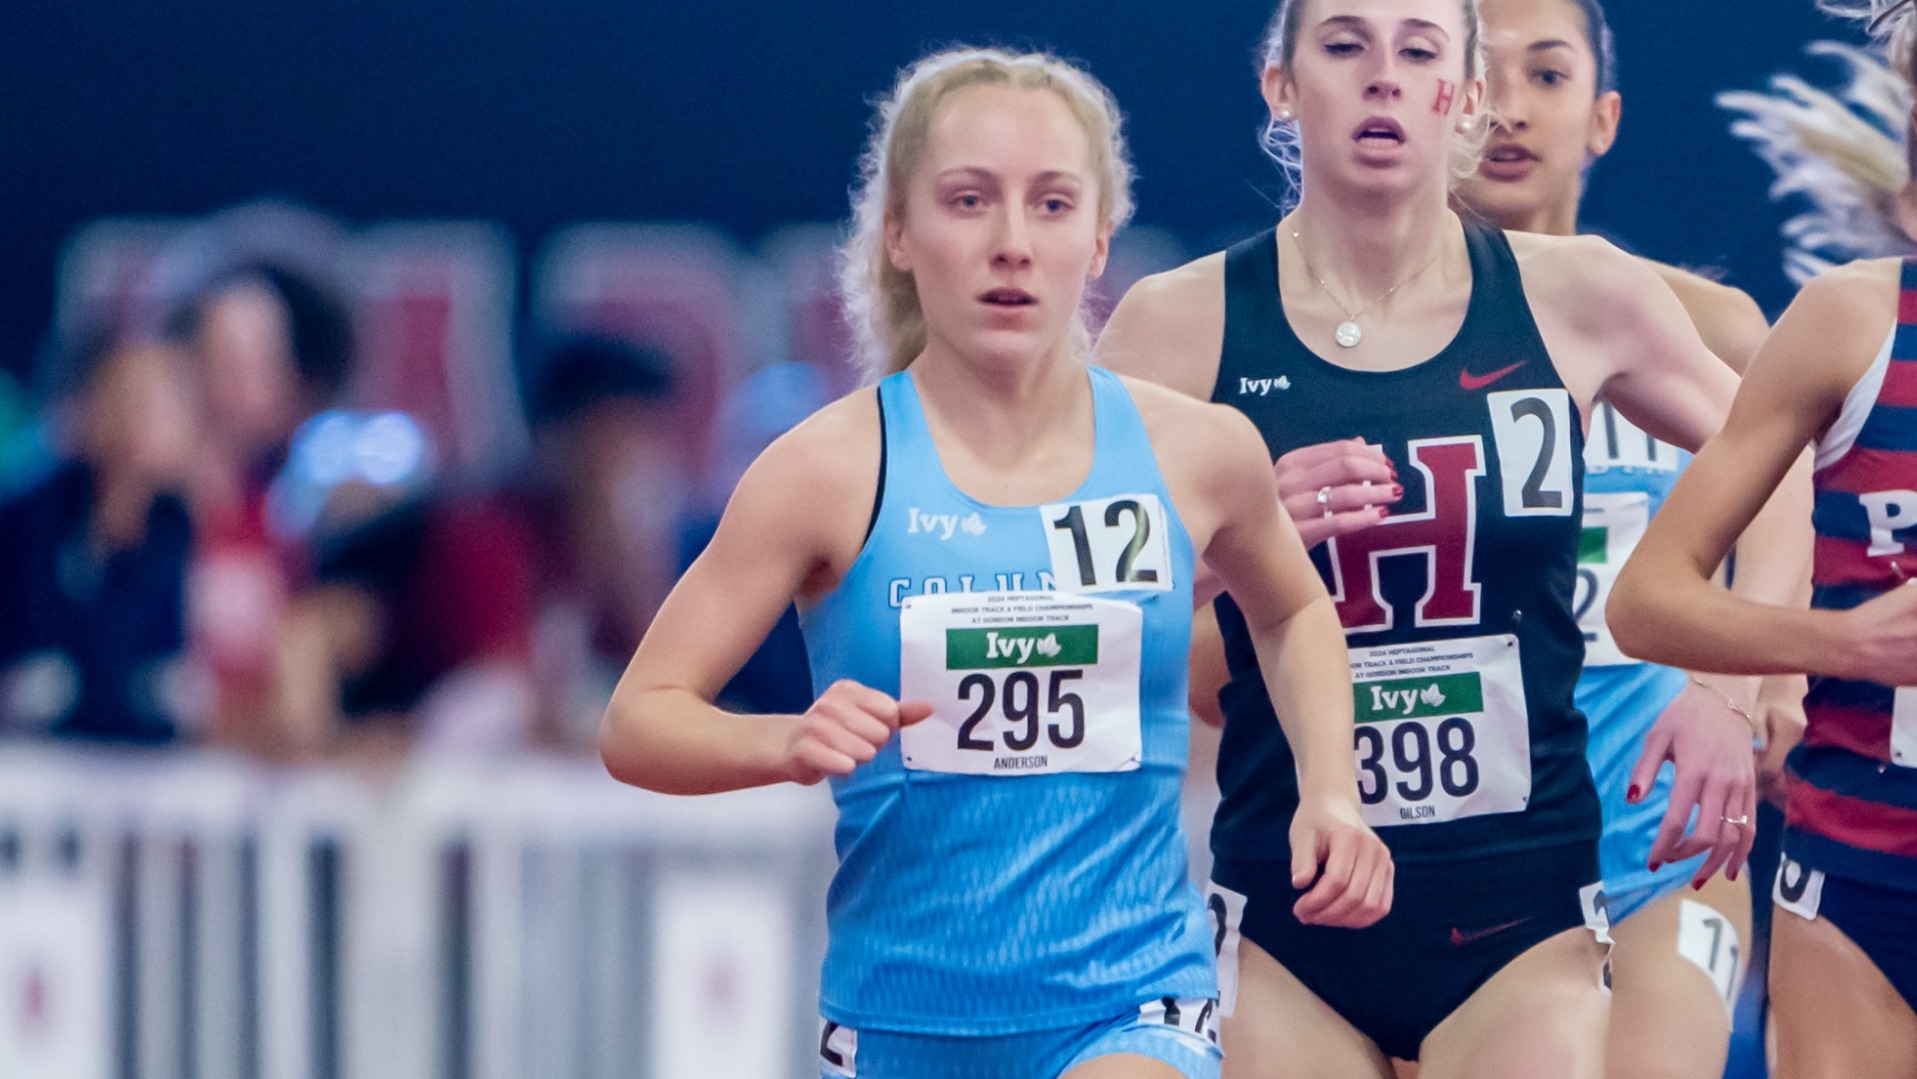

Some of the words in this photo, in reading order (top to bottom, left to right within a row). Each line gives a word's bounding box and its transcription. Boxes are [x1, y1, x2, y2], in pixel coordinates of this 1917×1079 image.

[1239, 377, 1272, 396] Ivy
[1510, 397, 1563, 509] 2
[908, 507, 958, 541] Ivy
[1328, 434, 1486, 634] H
[1053, 499, 1159, 587] 12
[986, 631, 1035, 664] Ivy
[1388, 646, 1435, 655] HEPTAGONAL
[1416, 652, 1474, 663] CHAMPIONSHIPS
[1366, 670, 1397, 678] GORDON
[1398, 667, 1426, 675] INDOOR
[957, 669, 1085, 751] 295
[1370, 685, 1418, 715] Ivy
[994, 755, 1048, 770] ANDERSON
[1354, 717, 1479, 805] 398
[1400, 805, 1436, 819] GILSON
